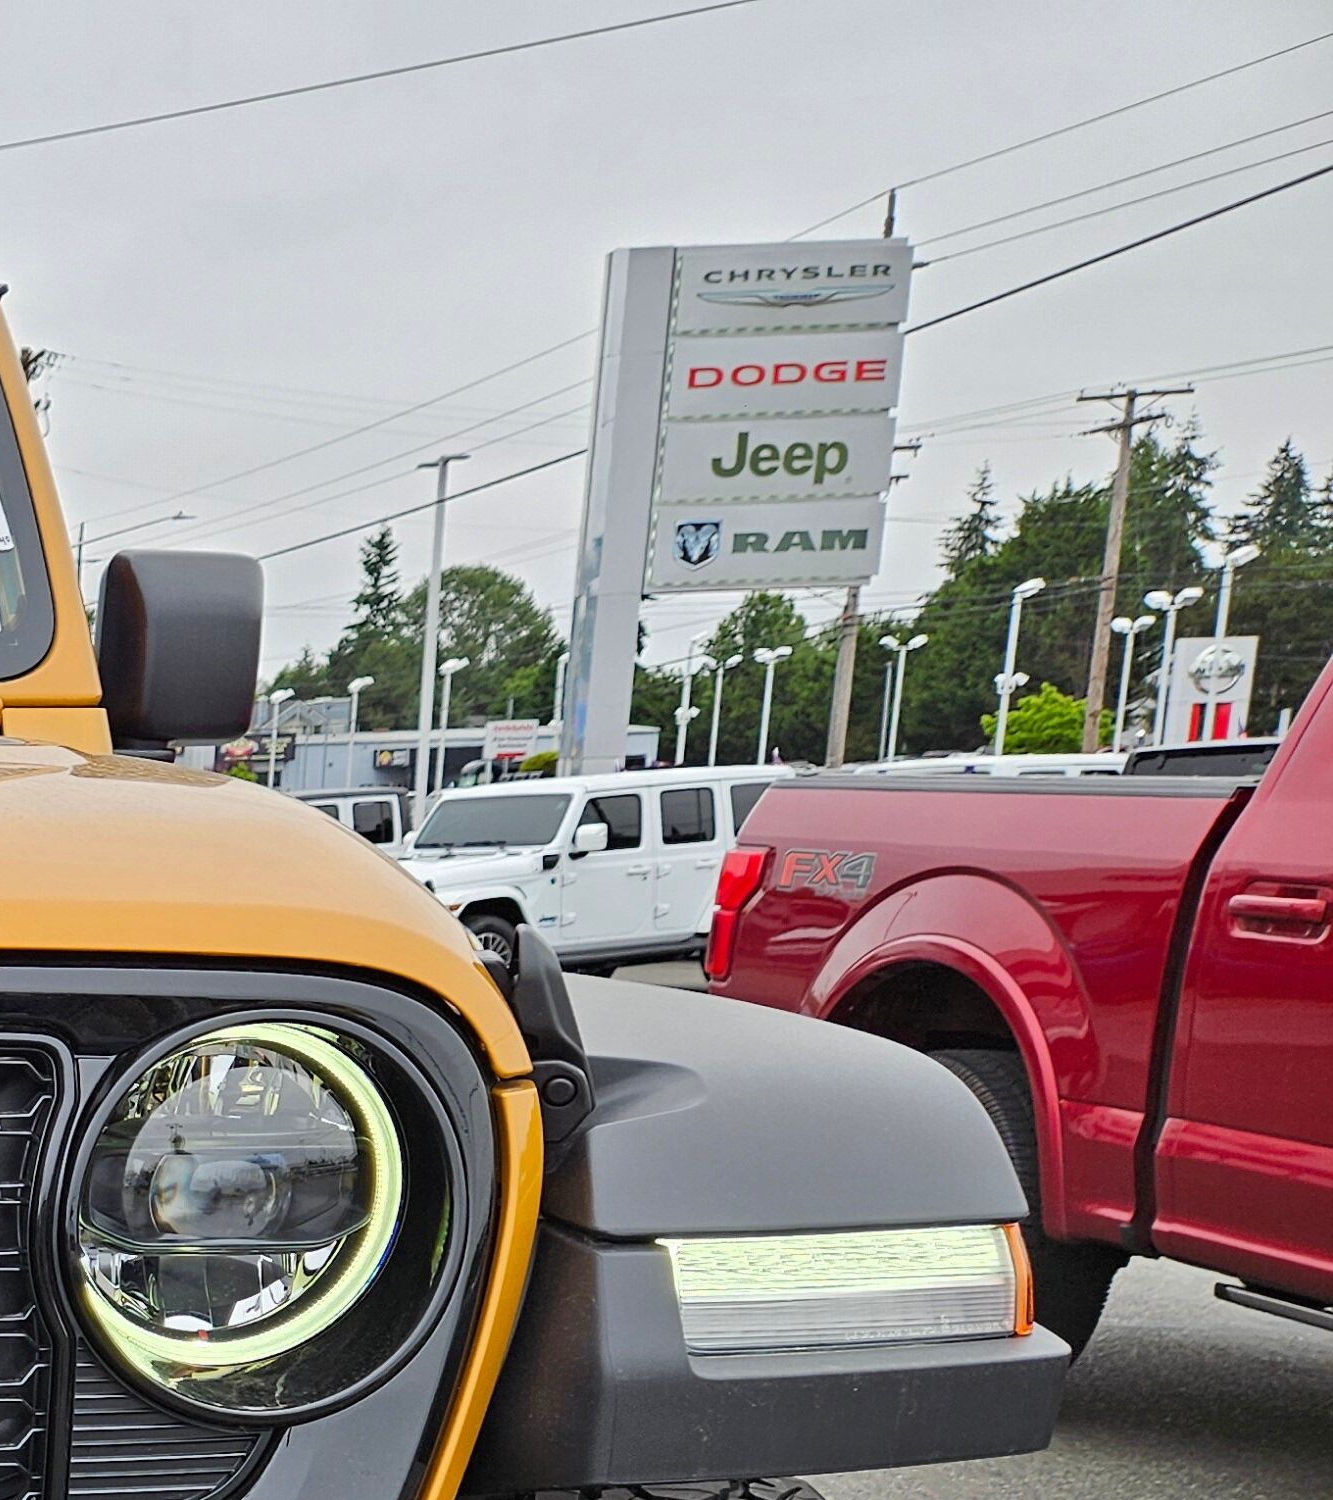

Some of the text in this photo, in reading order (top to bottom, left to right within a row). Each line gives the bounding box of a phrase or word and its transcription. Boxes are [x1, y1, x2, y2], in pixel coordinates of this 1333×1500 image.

[703, 264, 891, 284] CHRYSLER
[687, 359, 887, 389] DODGE
[711, 432, 849, 485] Jeep
[732, 529, 869, 554] RAM
[777, 850, 877, 889] FX4
